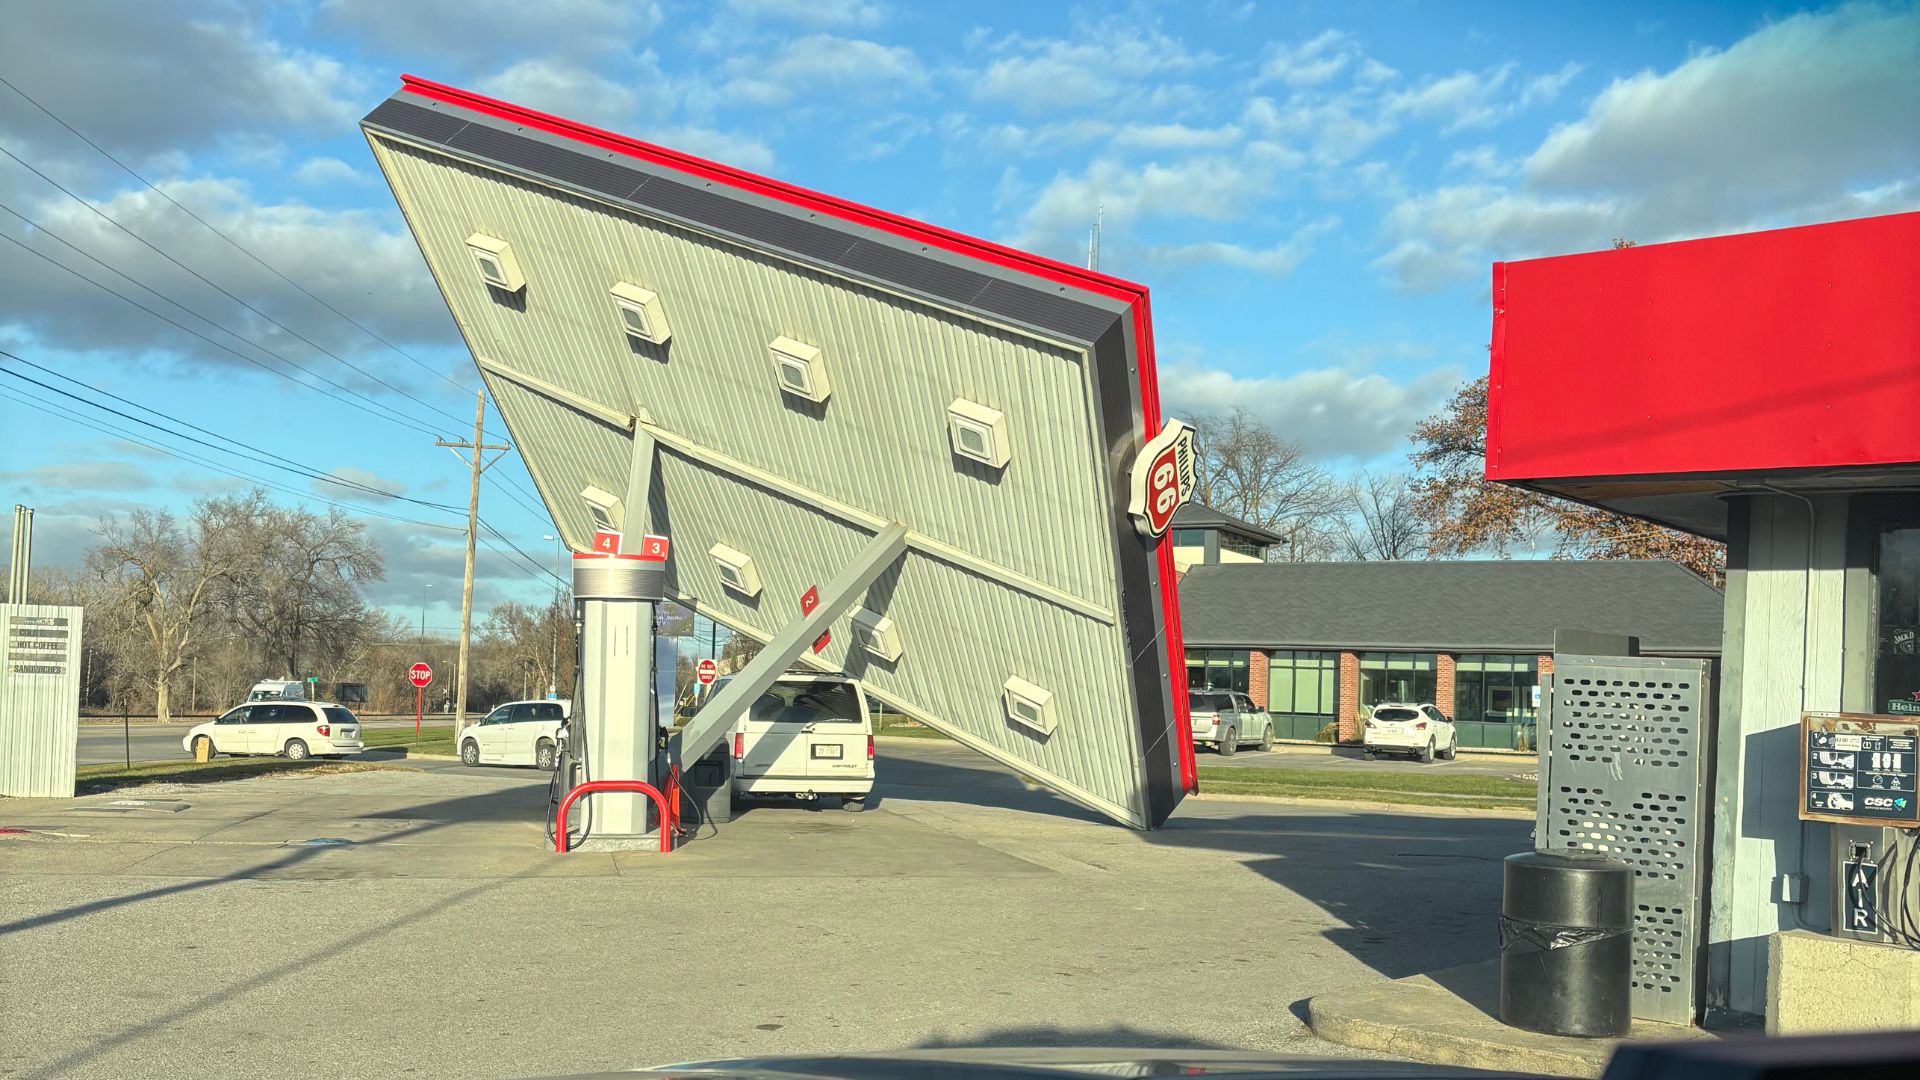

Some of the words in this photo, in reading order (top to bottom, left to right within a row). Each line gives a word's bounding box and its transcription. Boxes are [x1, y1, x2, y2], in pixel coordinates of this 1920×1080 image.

[1177, 436, 1191, 497] PHILLIPS
[1154, 463, 1177, 514] 66
[602, 537, 611, 549] 4
[651, 542, 661, 554] 3
[805, 595, 814, 608] 2
[1894, 633, 1909, 645] JACK
[17, 641, 31, 649] HOT
[33, 642, 59, 650] COFFEE
[14, 665, 61, 674] SANDWICHES
[411, 670, 430, 680] STOP
[1864, 797, 1893, 807] CSC
[1852, 869, 1869, 927] AIR
